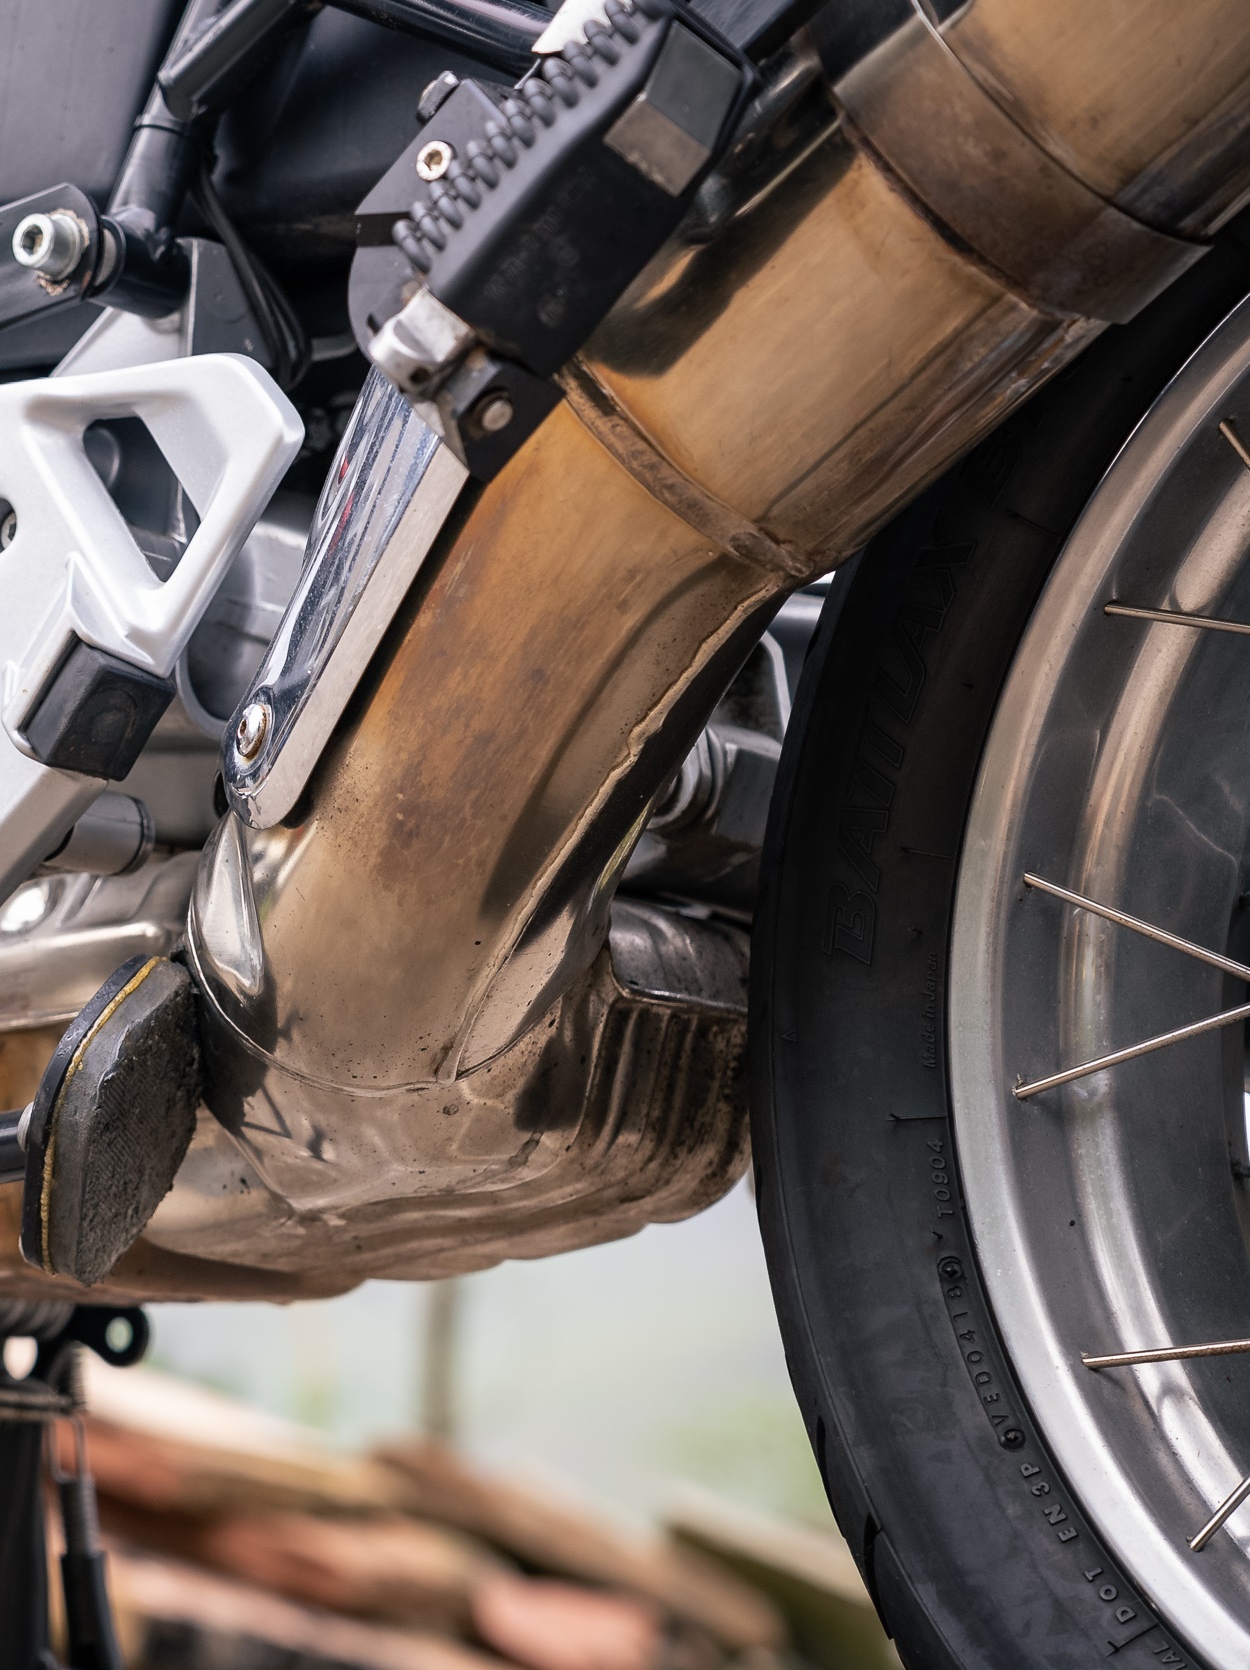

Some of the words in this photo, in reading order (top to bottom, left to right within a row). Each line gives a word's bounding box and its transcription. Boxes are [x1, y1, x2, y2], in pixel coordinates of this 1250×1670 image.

[921, 952, 938, 1002] Japan
[922, 1003, 937, 1020] in
[922, 1024, 937, 1069] Made
[1083, 1567, 1138, 1625] DOT
